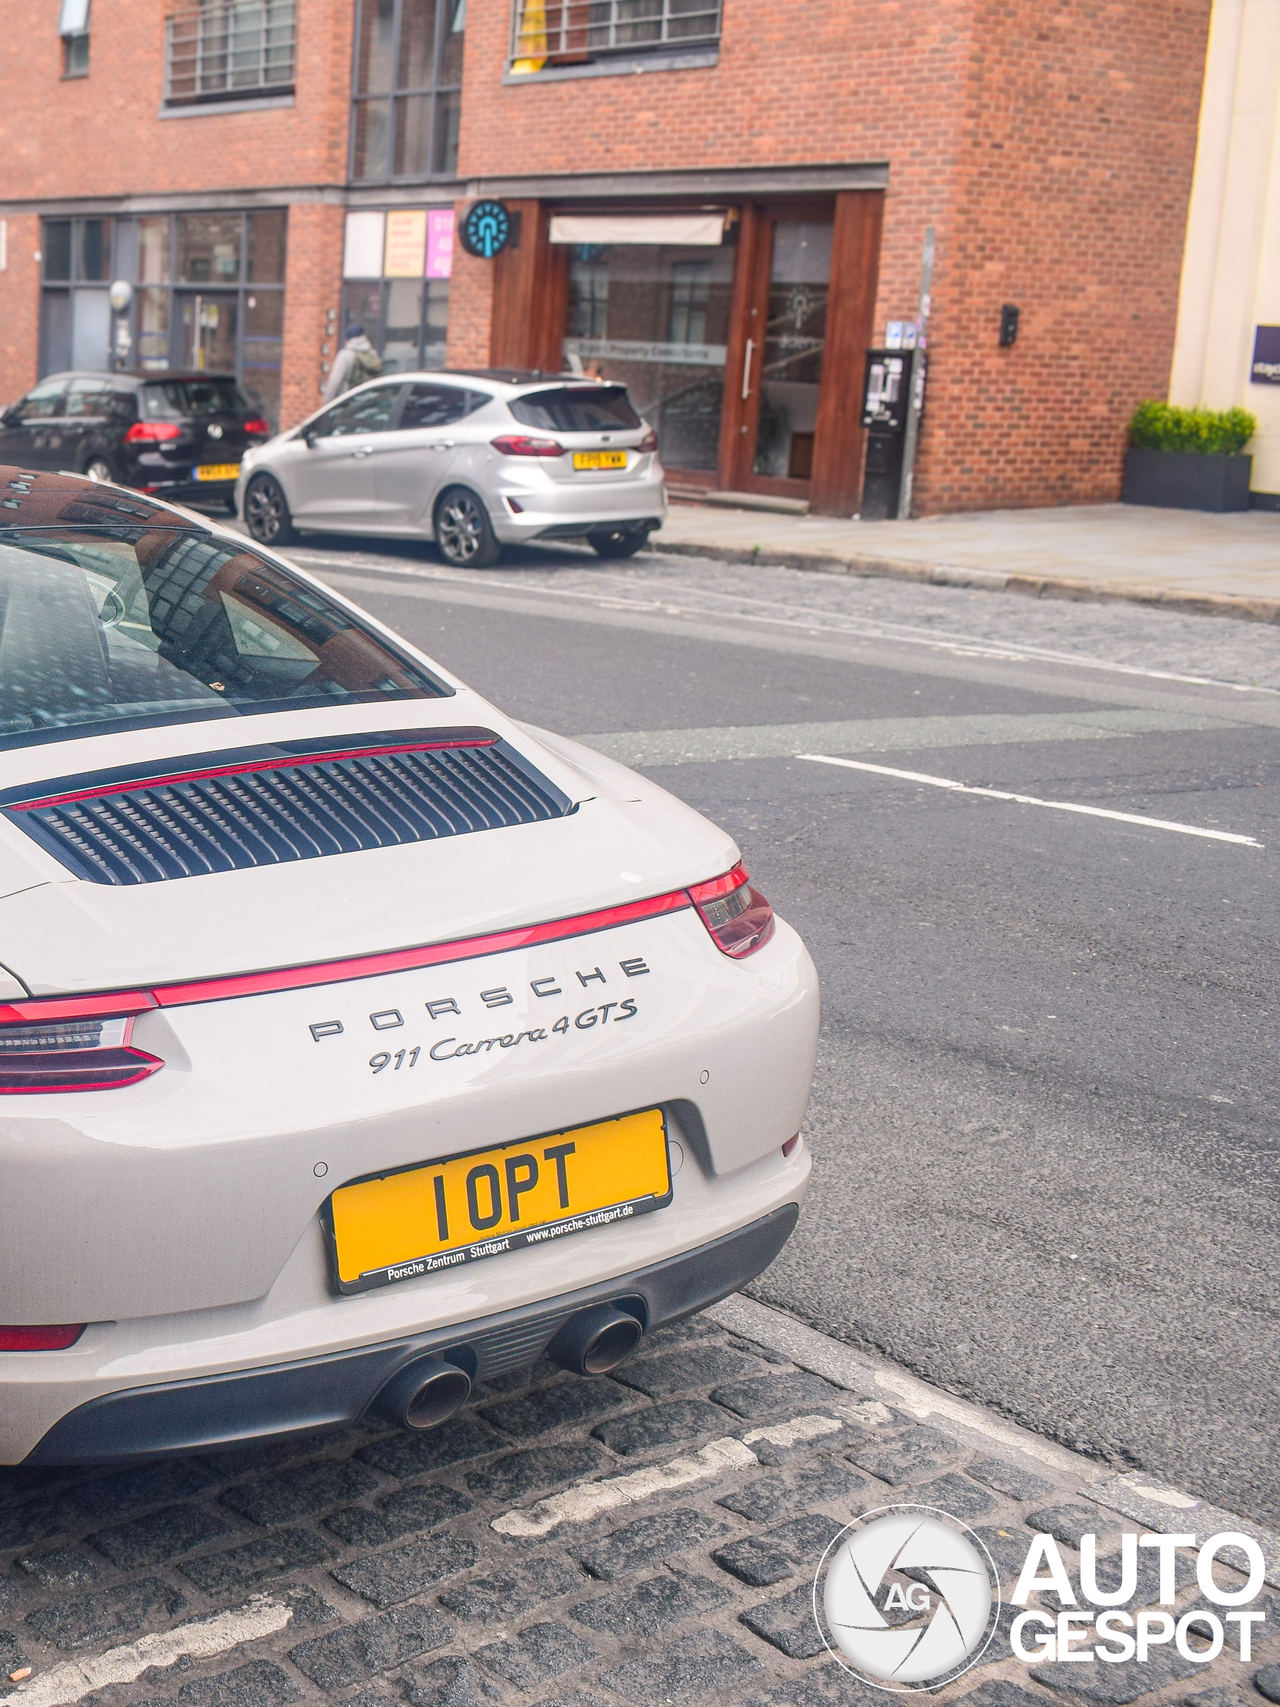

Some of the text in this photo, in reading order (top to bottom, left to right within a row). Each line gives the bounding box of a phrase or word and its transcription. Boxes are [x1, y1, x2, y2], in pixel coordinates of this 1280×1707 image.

[308, 957, 651, 1043] PORSCHE
[369, 1045, 421, 1075] 911
[429, 1027, 549, 1062] Carrera
[387, 1262, 425, 1281] Porsche
[426, 1251, 465, 1270] Zentrum
[470, 1239, 510, 1259] Stuttgart
[526, 1205, 634, 1243] www.porsche-stuttgart.de
